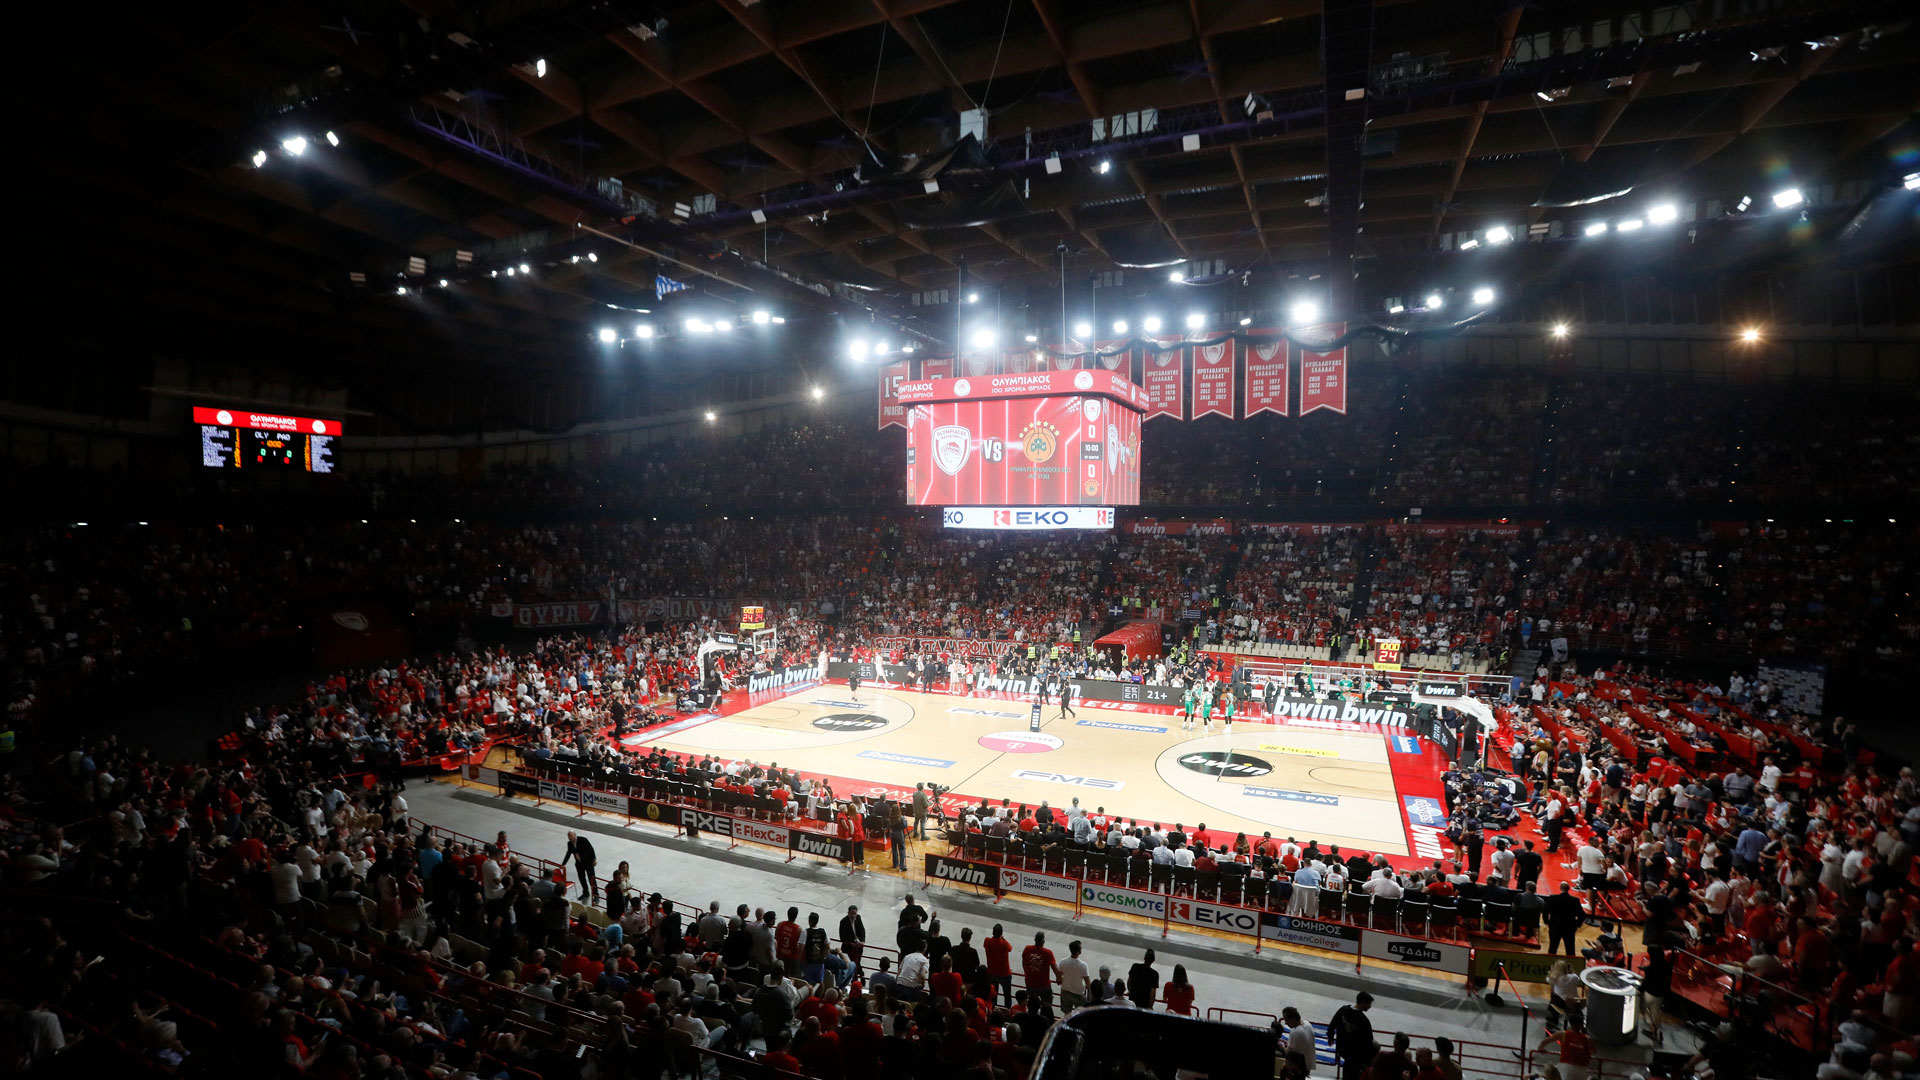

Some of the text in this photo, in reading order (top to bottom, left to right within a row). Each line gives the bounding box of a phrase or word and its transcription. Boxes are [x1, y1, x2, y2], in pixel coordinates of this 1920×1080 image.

[992, 374, 1050, 387] ΟΛΥΜΠΙΑΚΟΣ
[983, 439, 1002, 462] VS
[1016, 511, 1069, 525] EKO
[1133, 522, 1166, 535] bwin
[1378, 651, 1398, 662] 24
[748, 673, 783, 693] bwin
[1425, 685, 1456, 695] bwin
[1147, 690, 1168, 701] 21+
[1273, 696, 1338, 721] bwin
[1340, 699, 1408, 728] bwin
[1180, 755, 1272, 776] bwin
[1018, 770, 1119, 789] FMS
[540, 782, 580, 805] FMS
[594, 795, 618, 806] MARINE
[681, 810, 731, 835] AXE
[743, 824, 788, 845] FlexCar
[1410, 823, 1455, 860] bwin
[798, 835, 842, 858] bwin
[934, 860, 987, 886] bwin
[1023, 877, 1076, 892] ΟΜΙΛΟΣ ΙΑΤΡΙΚΟΥ
[1023, 884, 1050, 894] ΑΘΗΝΩΝ
[1097, 891, 1164, 913] COSMOTE
[1195, 907, 1256, 930] EKO
[1291, 919, 1342, 936] ΟΜΗΡΟΣ
[1278, 931, 1341, 949] AegeanCollege
[1391, 944, 1438, 960] ΔΕΔΔΗΕ
